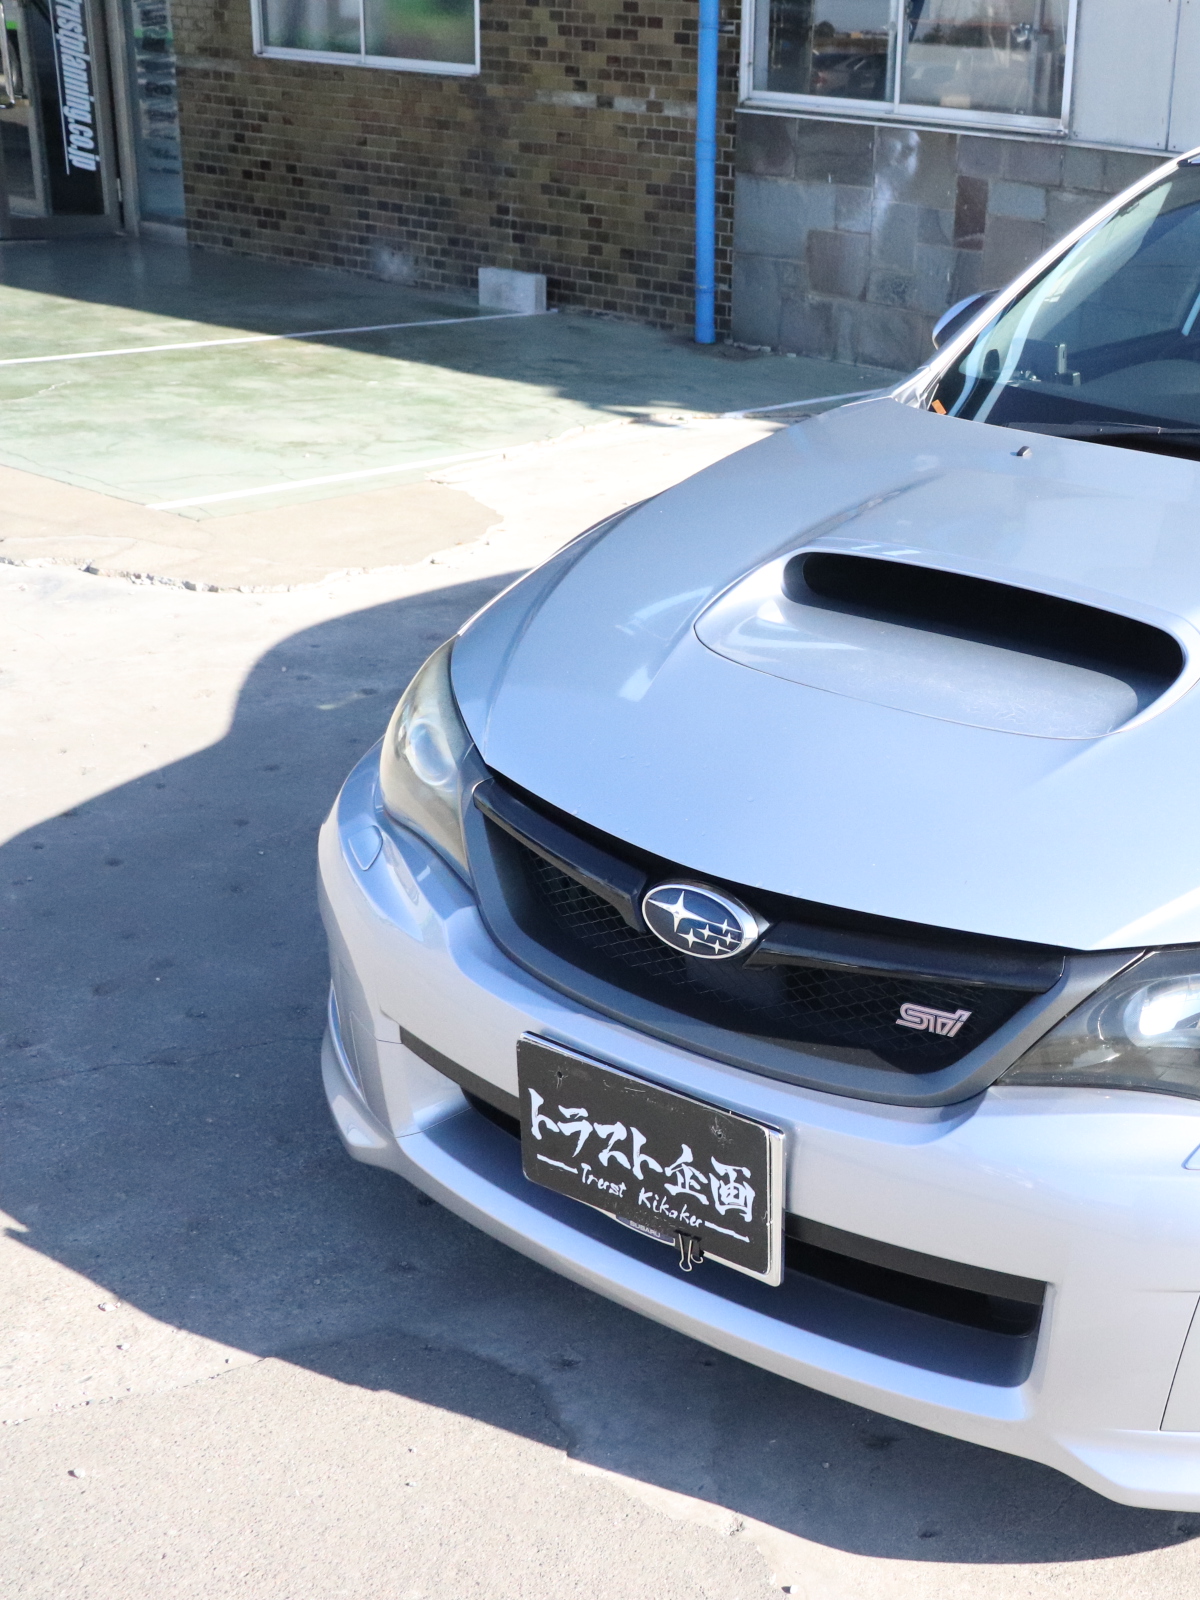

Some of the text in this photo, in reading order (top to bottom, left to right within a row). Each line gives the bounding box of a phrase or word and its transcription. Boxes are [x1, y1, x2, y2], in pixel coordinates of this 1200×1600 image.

[55, 0, 100, 171] rustplanning.co.jp
[528, 1087, 756, 1223] トラスト企画
